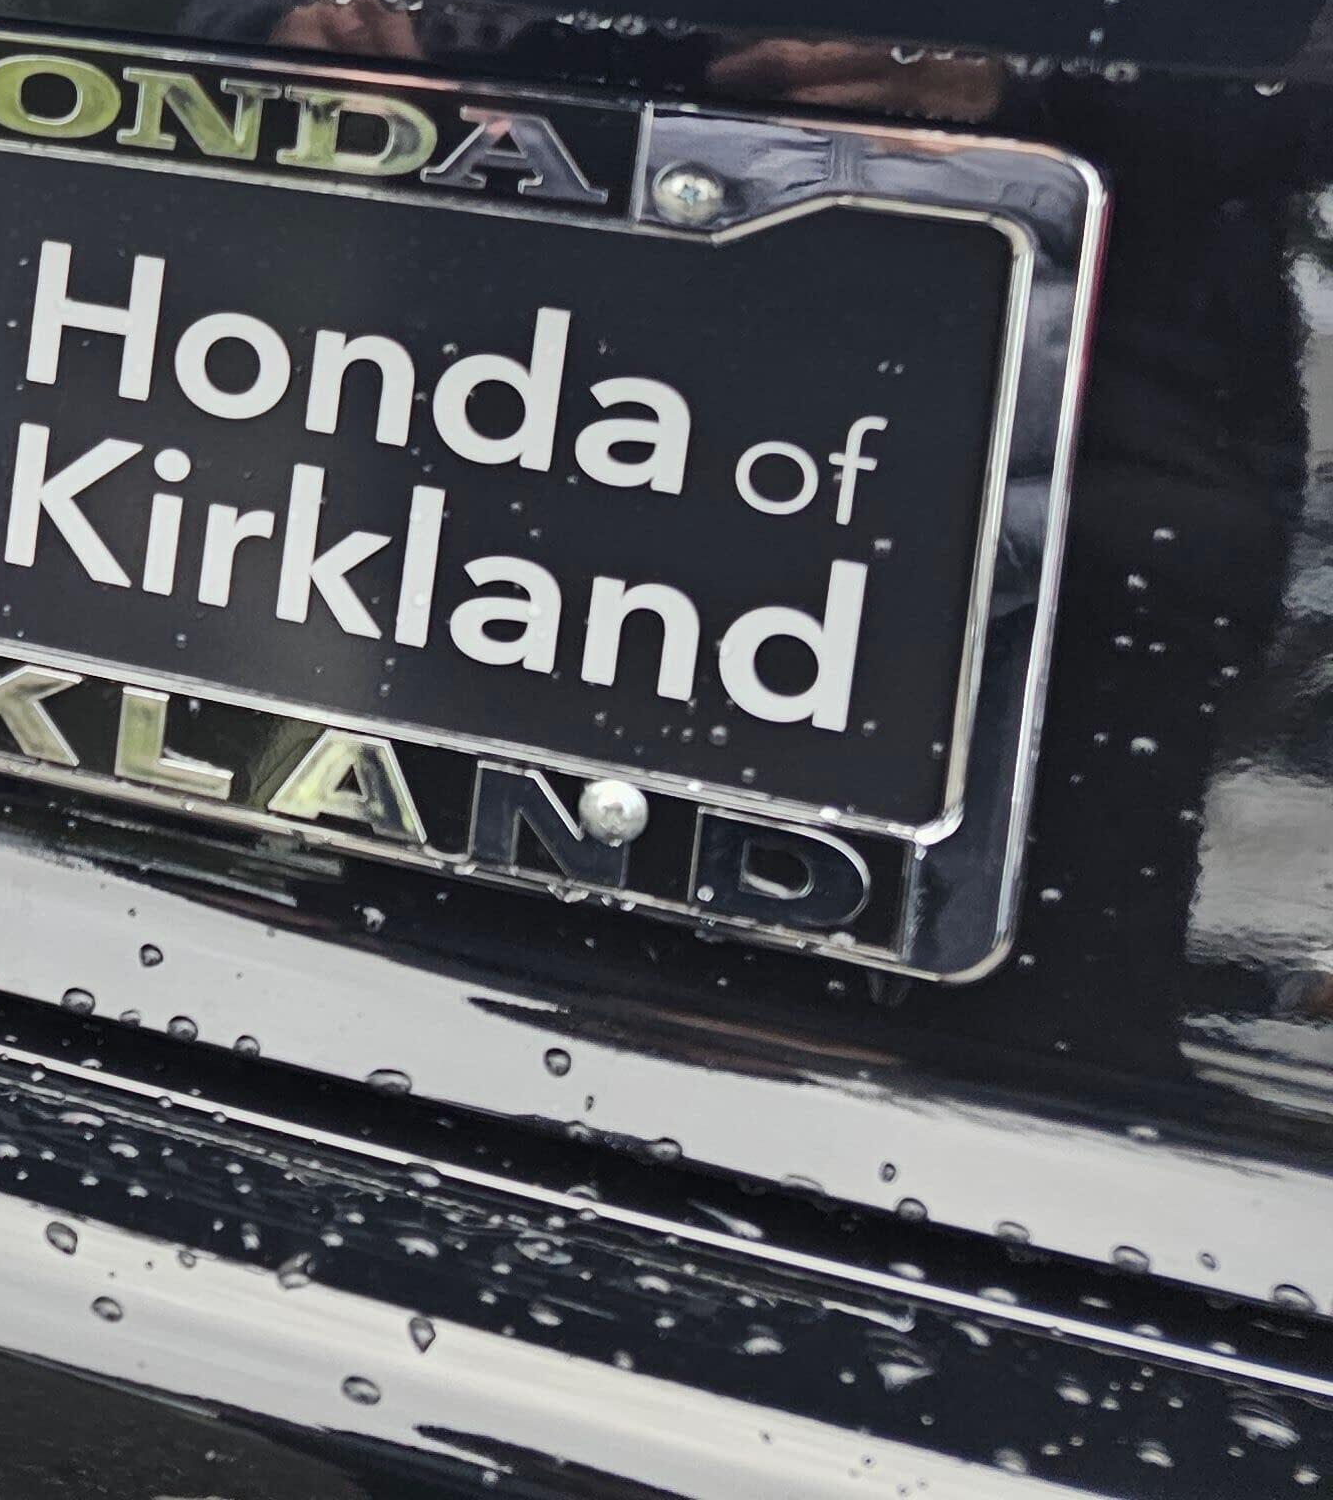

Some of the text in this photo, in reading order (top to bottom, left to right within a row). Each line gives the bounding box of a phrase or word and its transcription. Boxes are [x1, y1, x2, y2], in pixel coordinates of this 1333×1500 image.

[23, 240, 888, 526] Honda of
[2, 422, 868, 733] Kirkland
